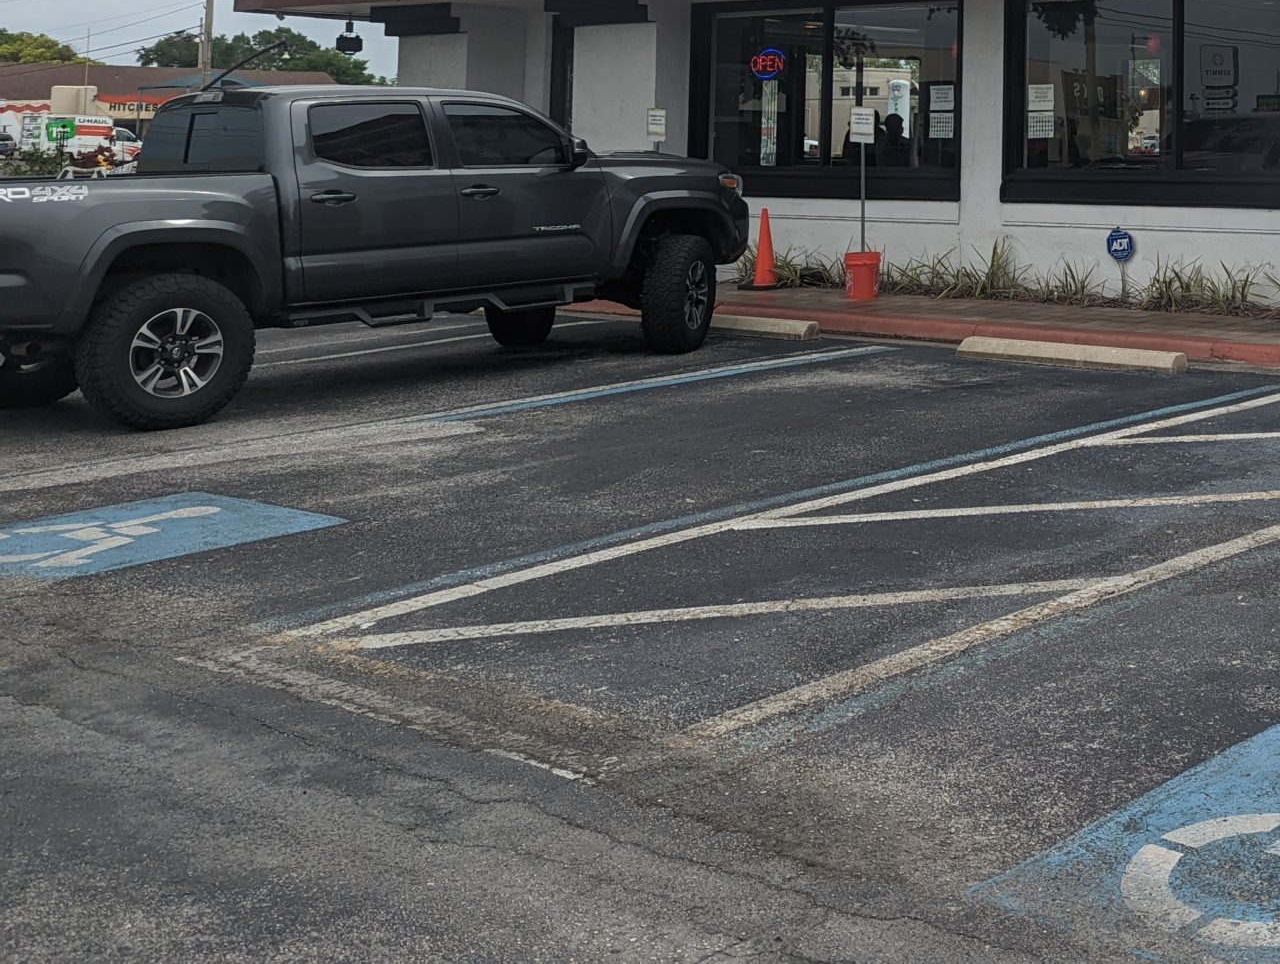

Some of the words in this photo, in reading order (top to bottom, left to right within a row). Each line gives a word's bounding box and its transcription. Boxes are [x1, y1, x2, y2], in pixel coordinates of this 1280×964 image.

[750, 55, 785, 72] OPEN
[109, 102, 159, 112] HITCHES
[32, 195, 84, 203] SPORT
[532, 223, 582, 231] TACOMA
[1111, 238, 1129, 251] ADT
